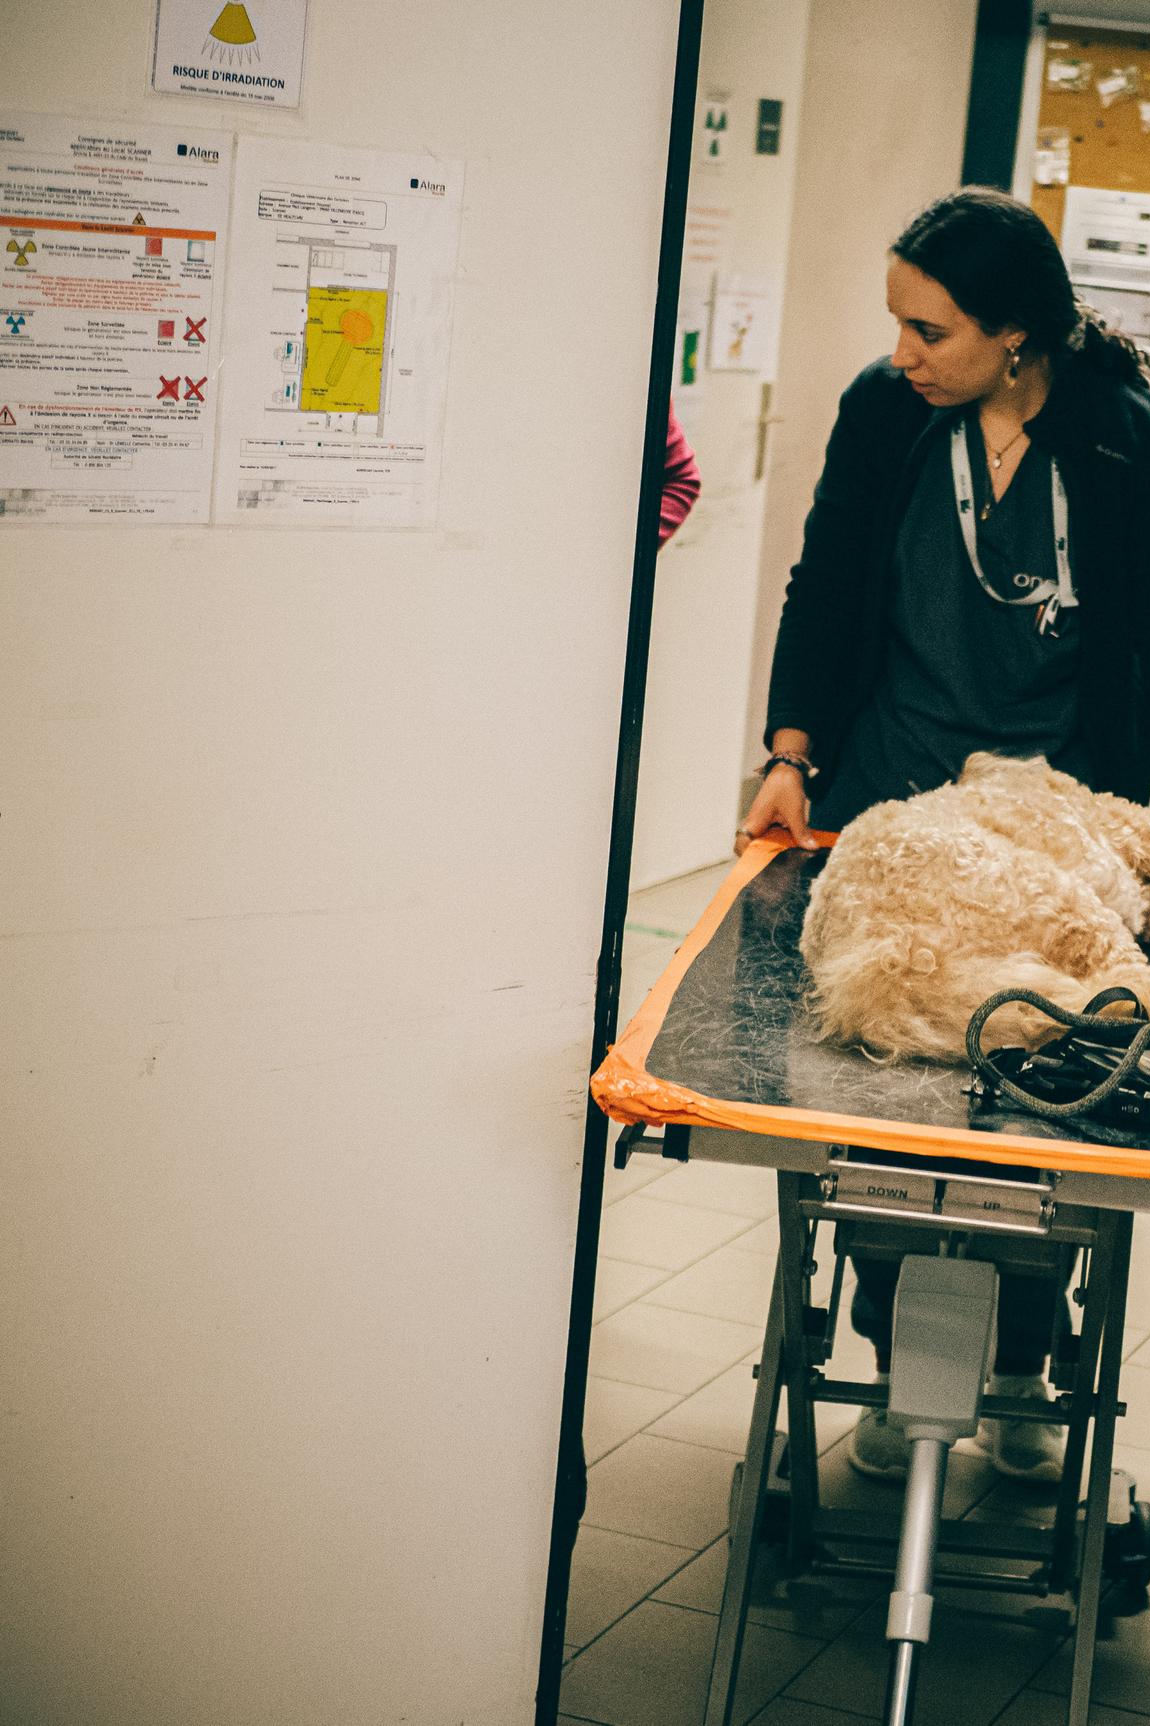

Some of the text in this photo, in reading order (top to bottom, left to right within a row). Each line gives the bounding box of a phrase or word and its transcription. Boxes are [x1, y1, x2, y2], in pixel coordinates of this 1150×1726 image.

[172, 65, 285, 89] RISQUE D'IRRADIATION
[189, 147, 219, 159] Alara
[420, 180, 446, 192] Alara
[867, 1185, 908, 1200] DOWN
[983, 1201, 1001, 1211] UP
